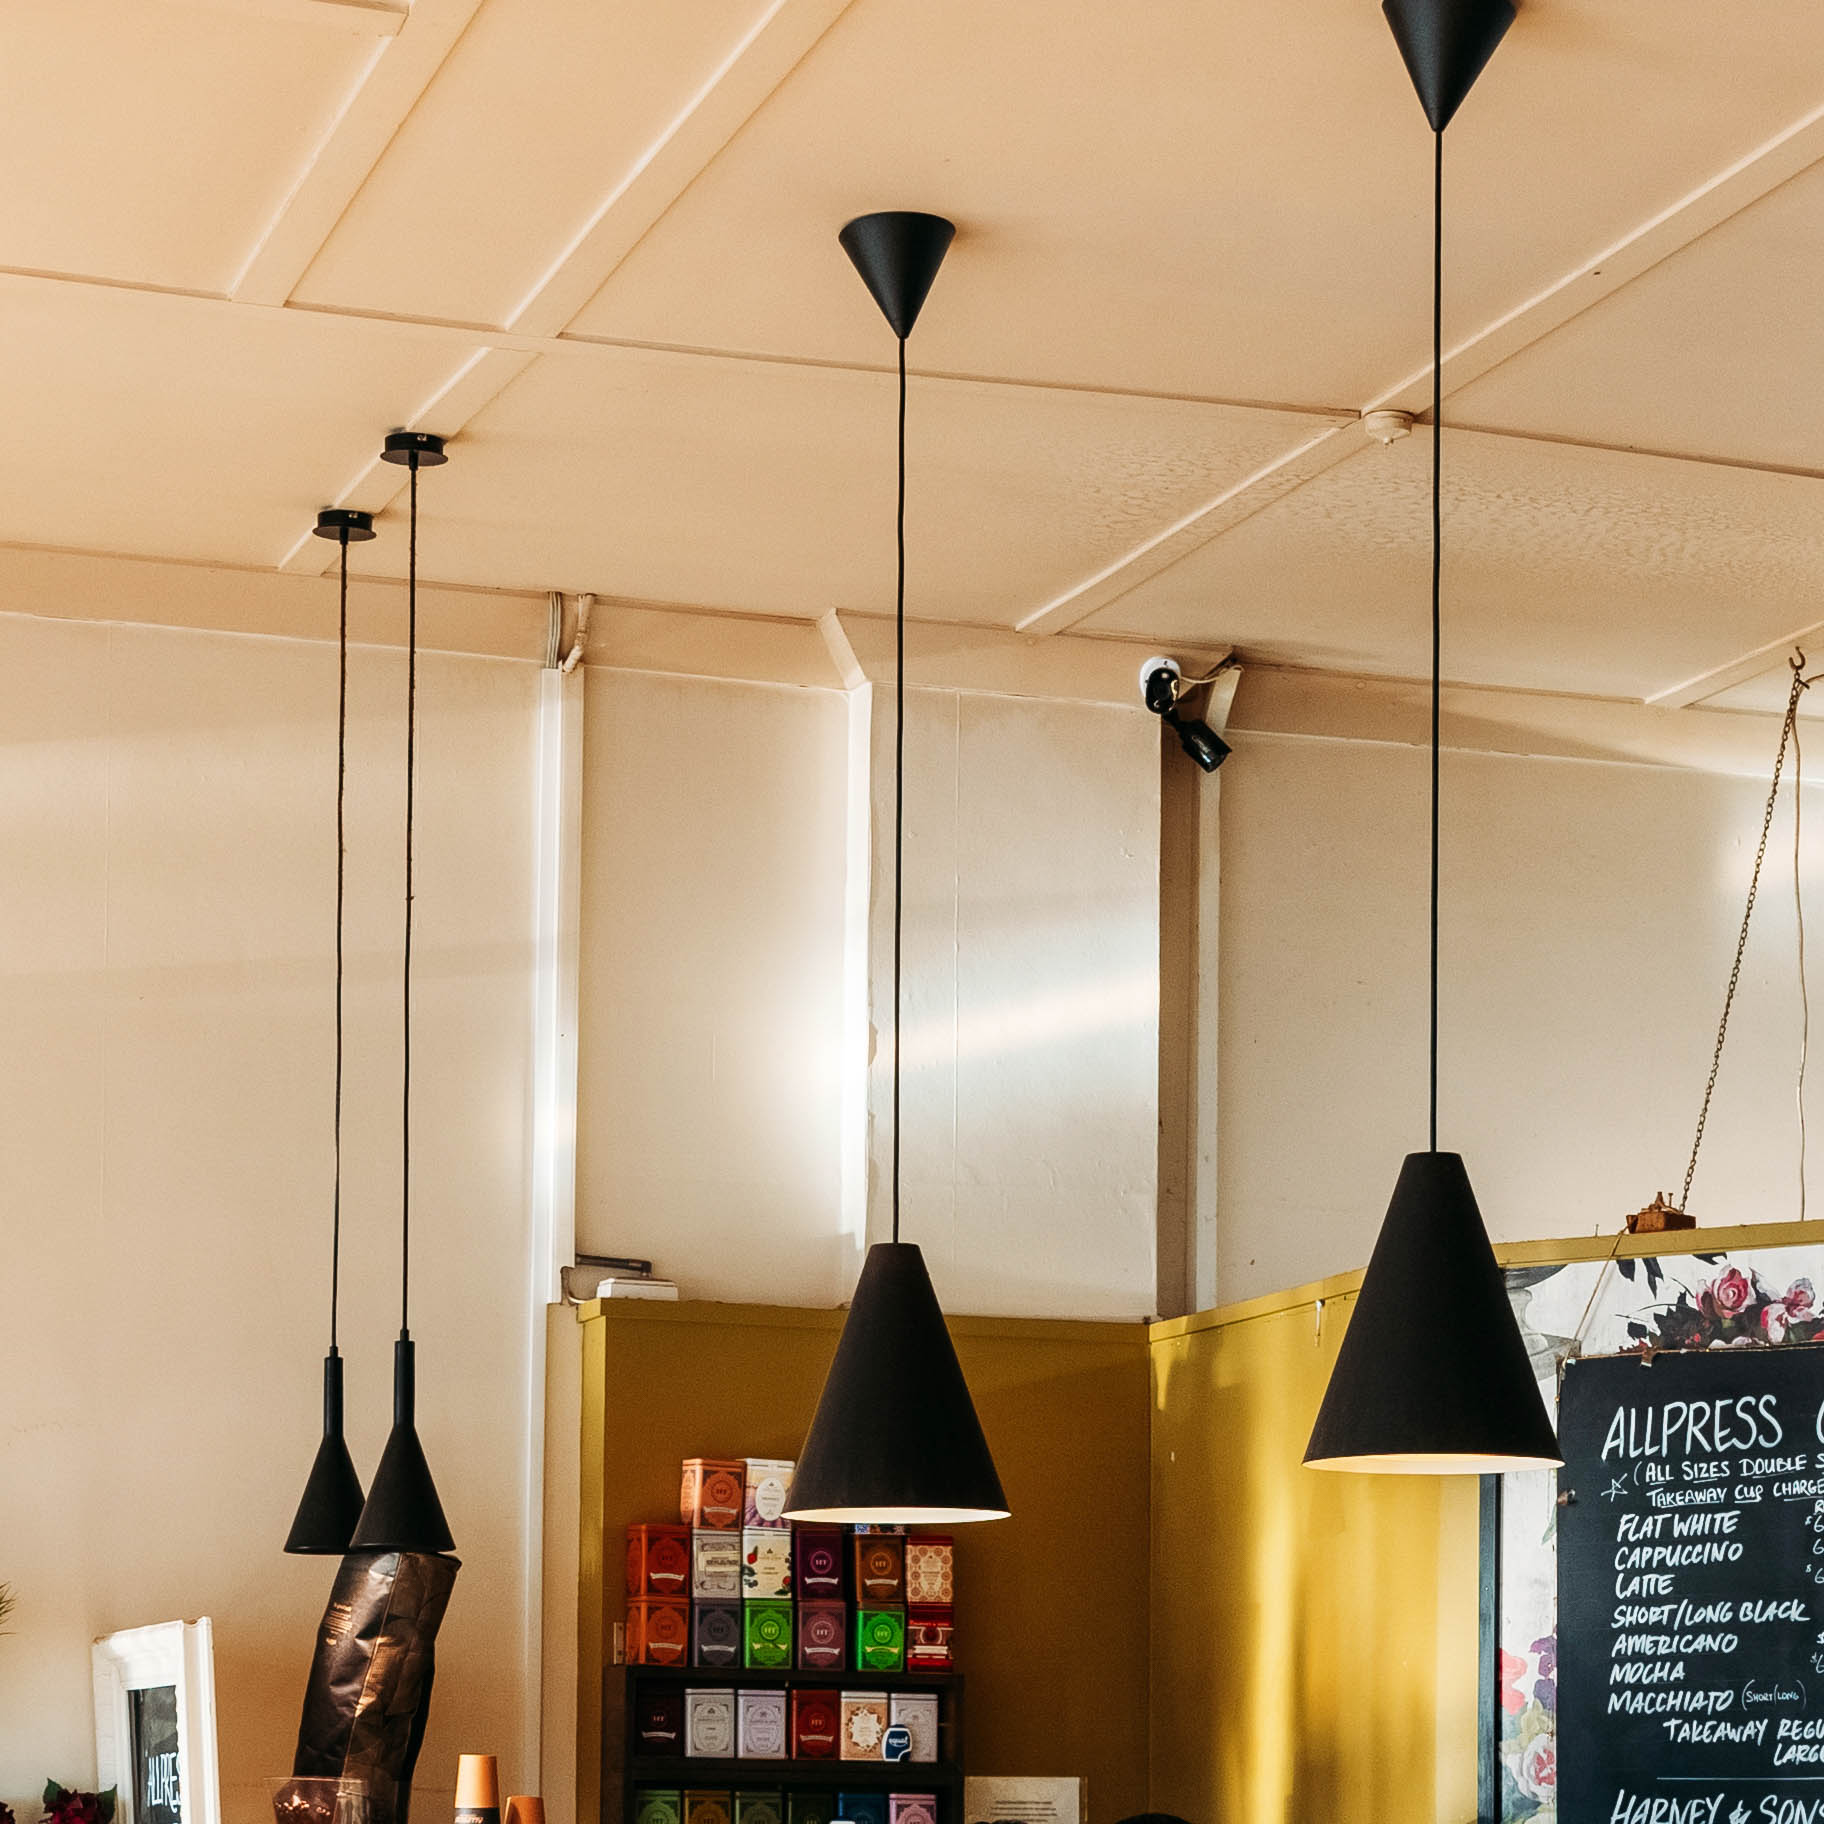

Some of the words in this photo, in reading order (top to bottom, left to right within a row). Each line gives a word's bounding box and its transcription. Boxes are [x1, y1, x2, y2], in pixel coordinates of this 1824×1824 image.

[1602, 1394, 1783, 1460] ALLPRESS
[1683, 1461, 1730, 1482] SIZES
[1740, 1455, 1807, 1478] DOUBLE
[1647, 1487, 1727, 1508] TAKEAWAY
[1617, 1513, 1670, 1542] FLAT
[1672, 1511, 1742, 1538] WHITE
[1614, 1543, 1744, 1571] CAPPUCCINO
[1616, 1574, 1675, 1598] LATTE
[1740, 1600, 1810, 1623] BLACK
[1611, 1633, 1738, 1658] AMERICANO
[1610, 1661, 1685, 1685] MOCHA
[1608, 1689, 1734, 1714] MACCHIATO
[1664, 1717, 1768, 1745] TAKEAWAY
